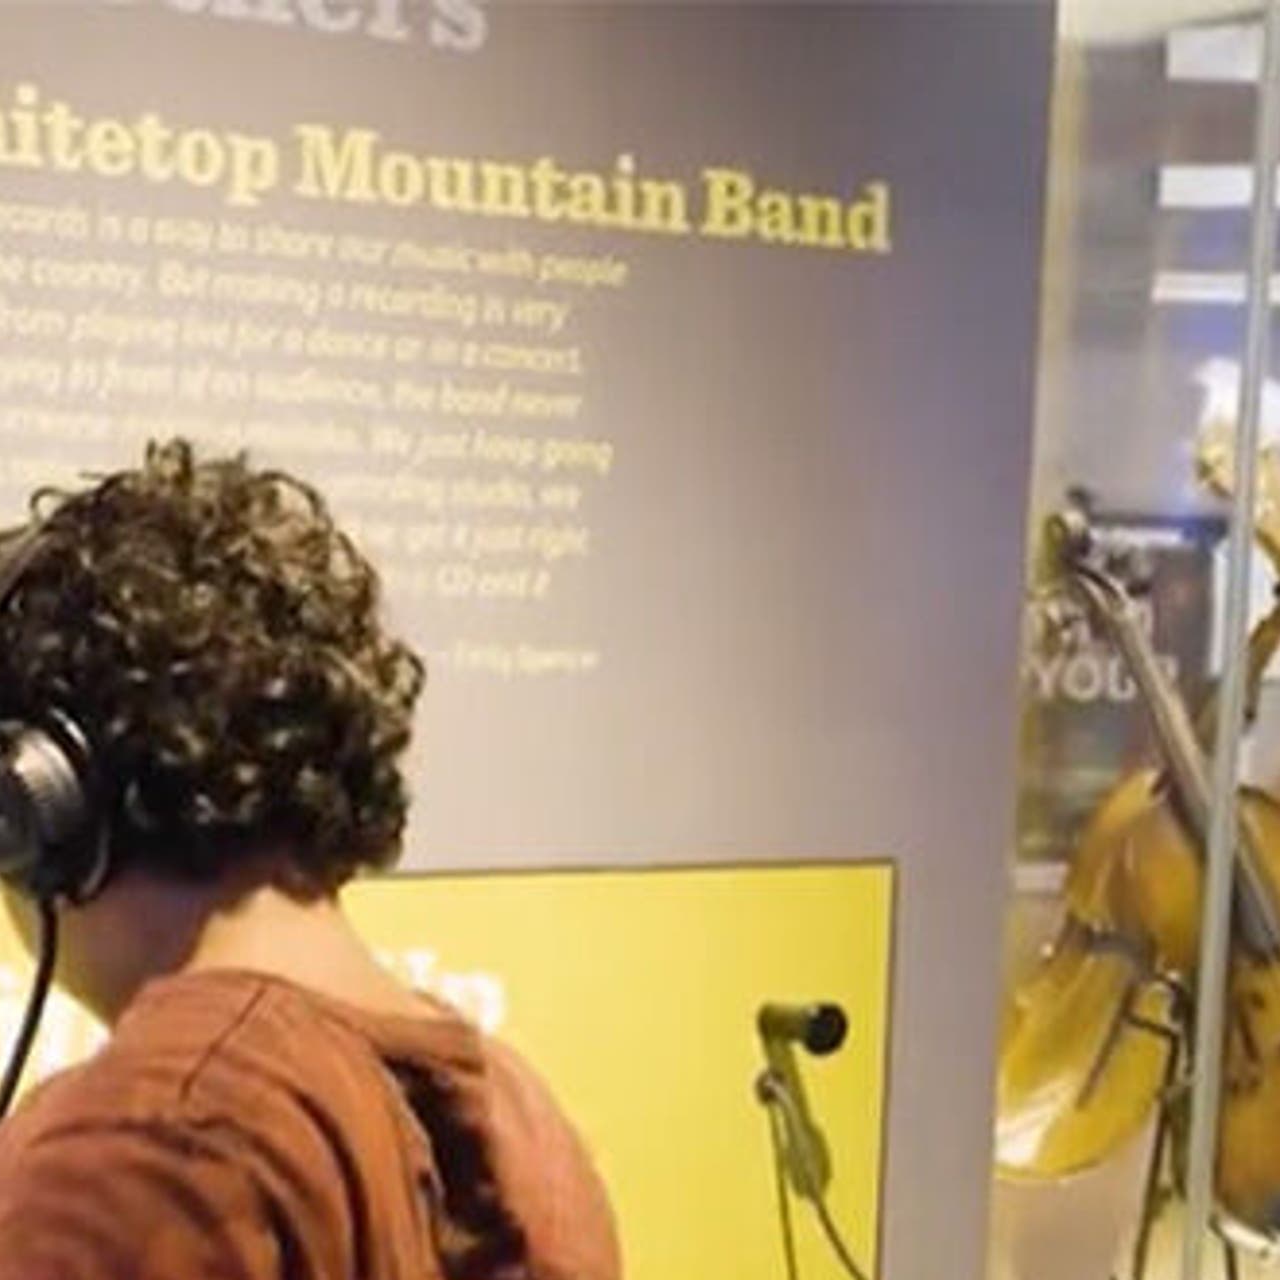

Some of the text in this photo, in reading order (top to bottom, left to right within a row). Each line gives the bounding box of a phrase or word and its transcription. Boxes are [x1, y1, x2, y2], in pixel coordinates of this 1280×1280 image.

[165, 0, 490, 53] ers
[293, 121, 688, 237] Mountain
[700, 167, 891, 254] Band
[538, 252, 629, 287] people
[348, 282, 477, 328] recording
